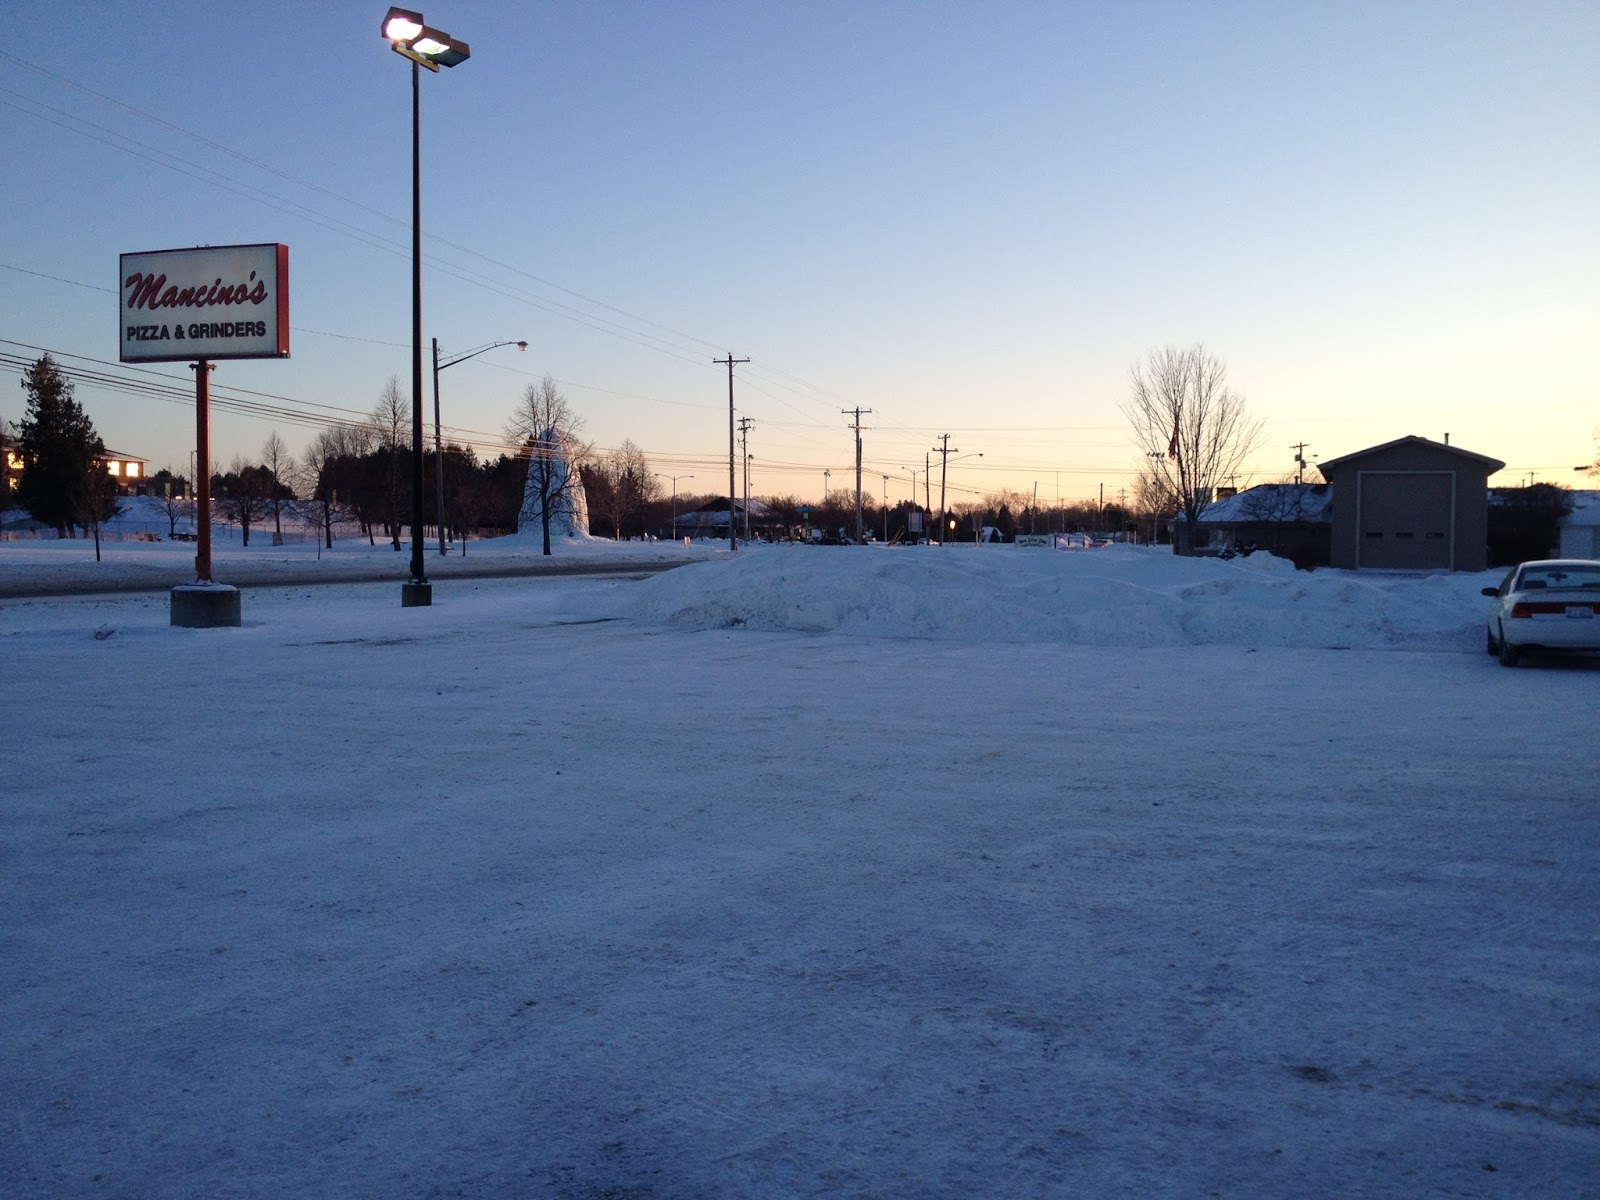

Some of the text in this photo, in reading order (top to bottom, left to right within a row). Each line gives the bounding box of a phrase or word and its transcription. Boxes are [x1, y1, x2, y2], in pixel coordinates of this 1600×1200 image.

[125, 270, 268, 310] Mancino's
[126, 320, 267, 341] PIZZA & GRINDERS
